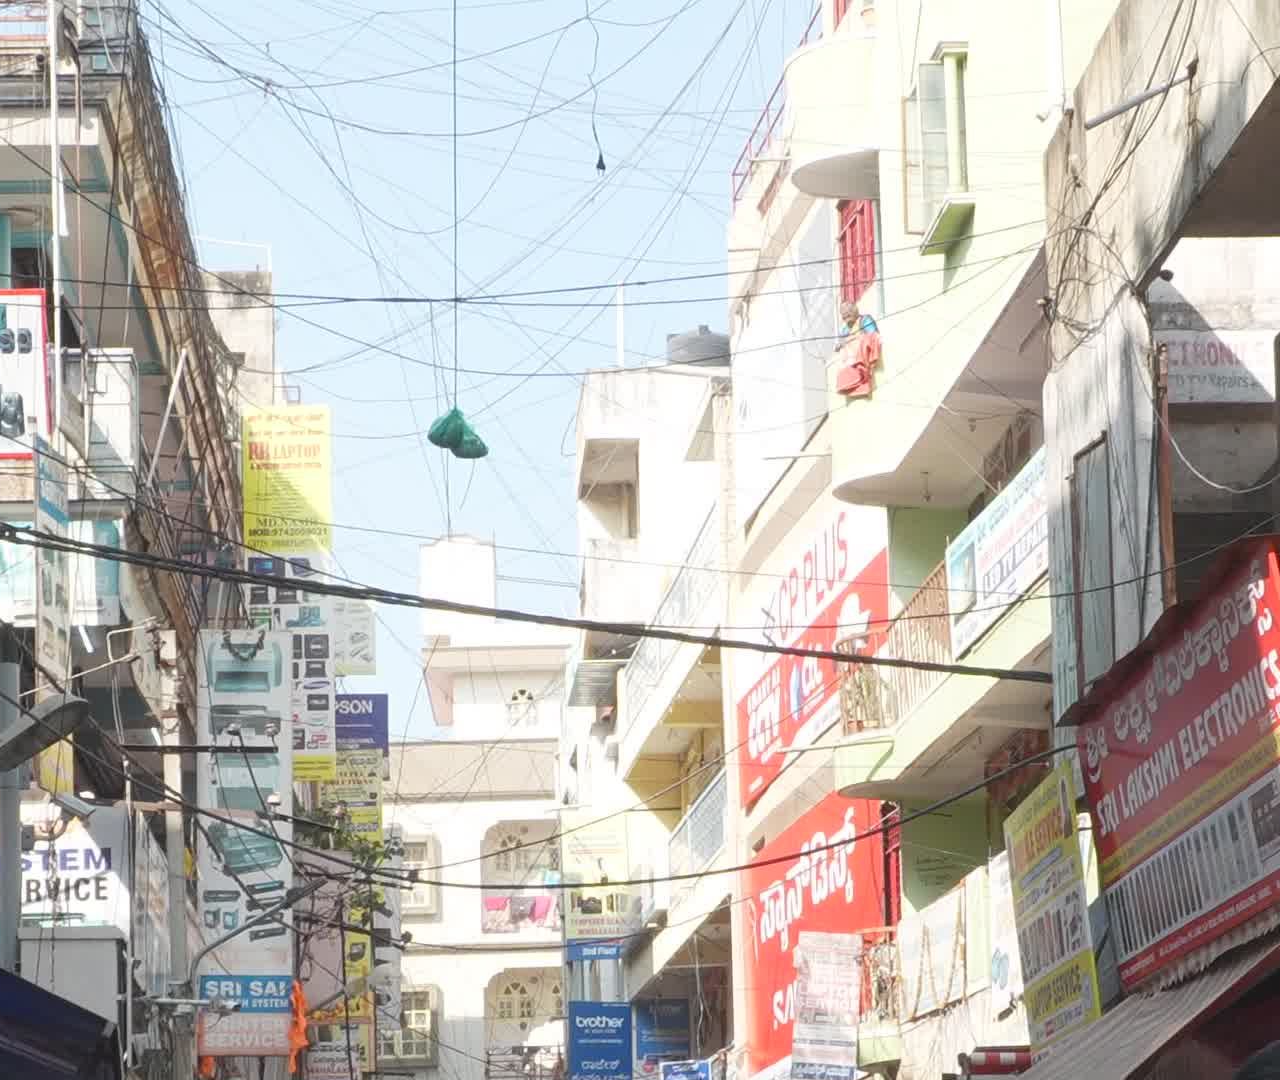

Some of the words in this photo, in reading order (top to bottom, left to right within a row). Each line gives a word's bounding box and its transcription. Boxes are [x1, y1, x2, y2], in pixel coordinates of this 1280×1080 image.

[778, 567, 800, 641] CP
[803, 511, 848, 617] PLUS
[1096, 791, 1119, 838] SRI
[1118, 747, 1180, 823] LAKSHMI
[204, 980, 242, 997] SRI
[575, 1015, 625, 1029] brother
